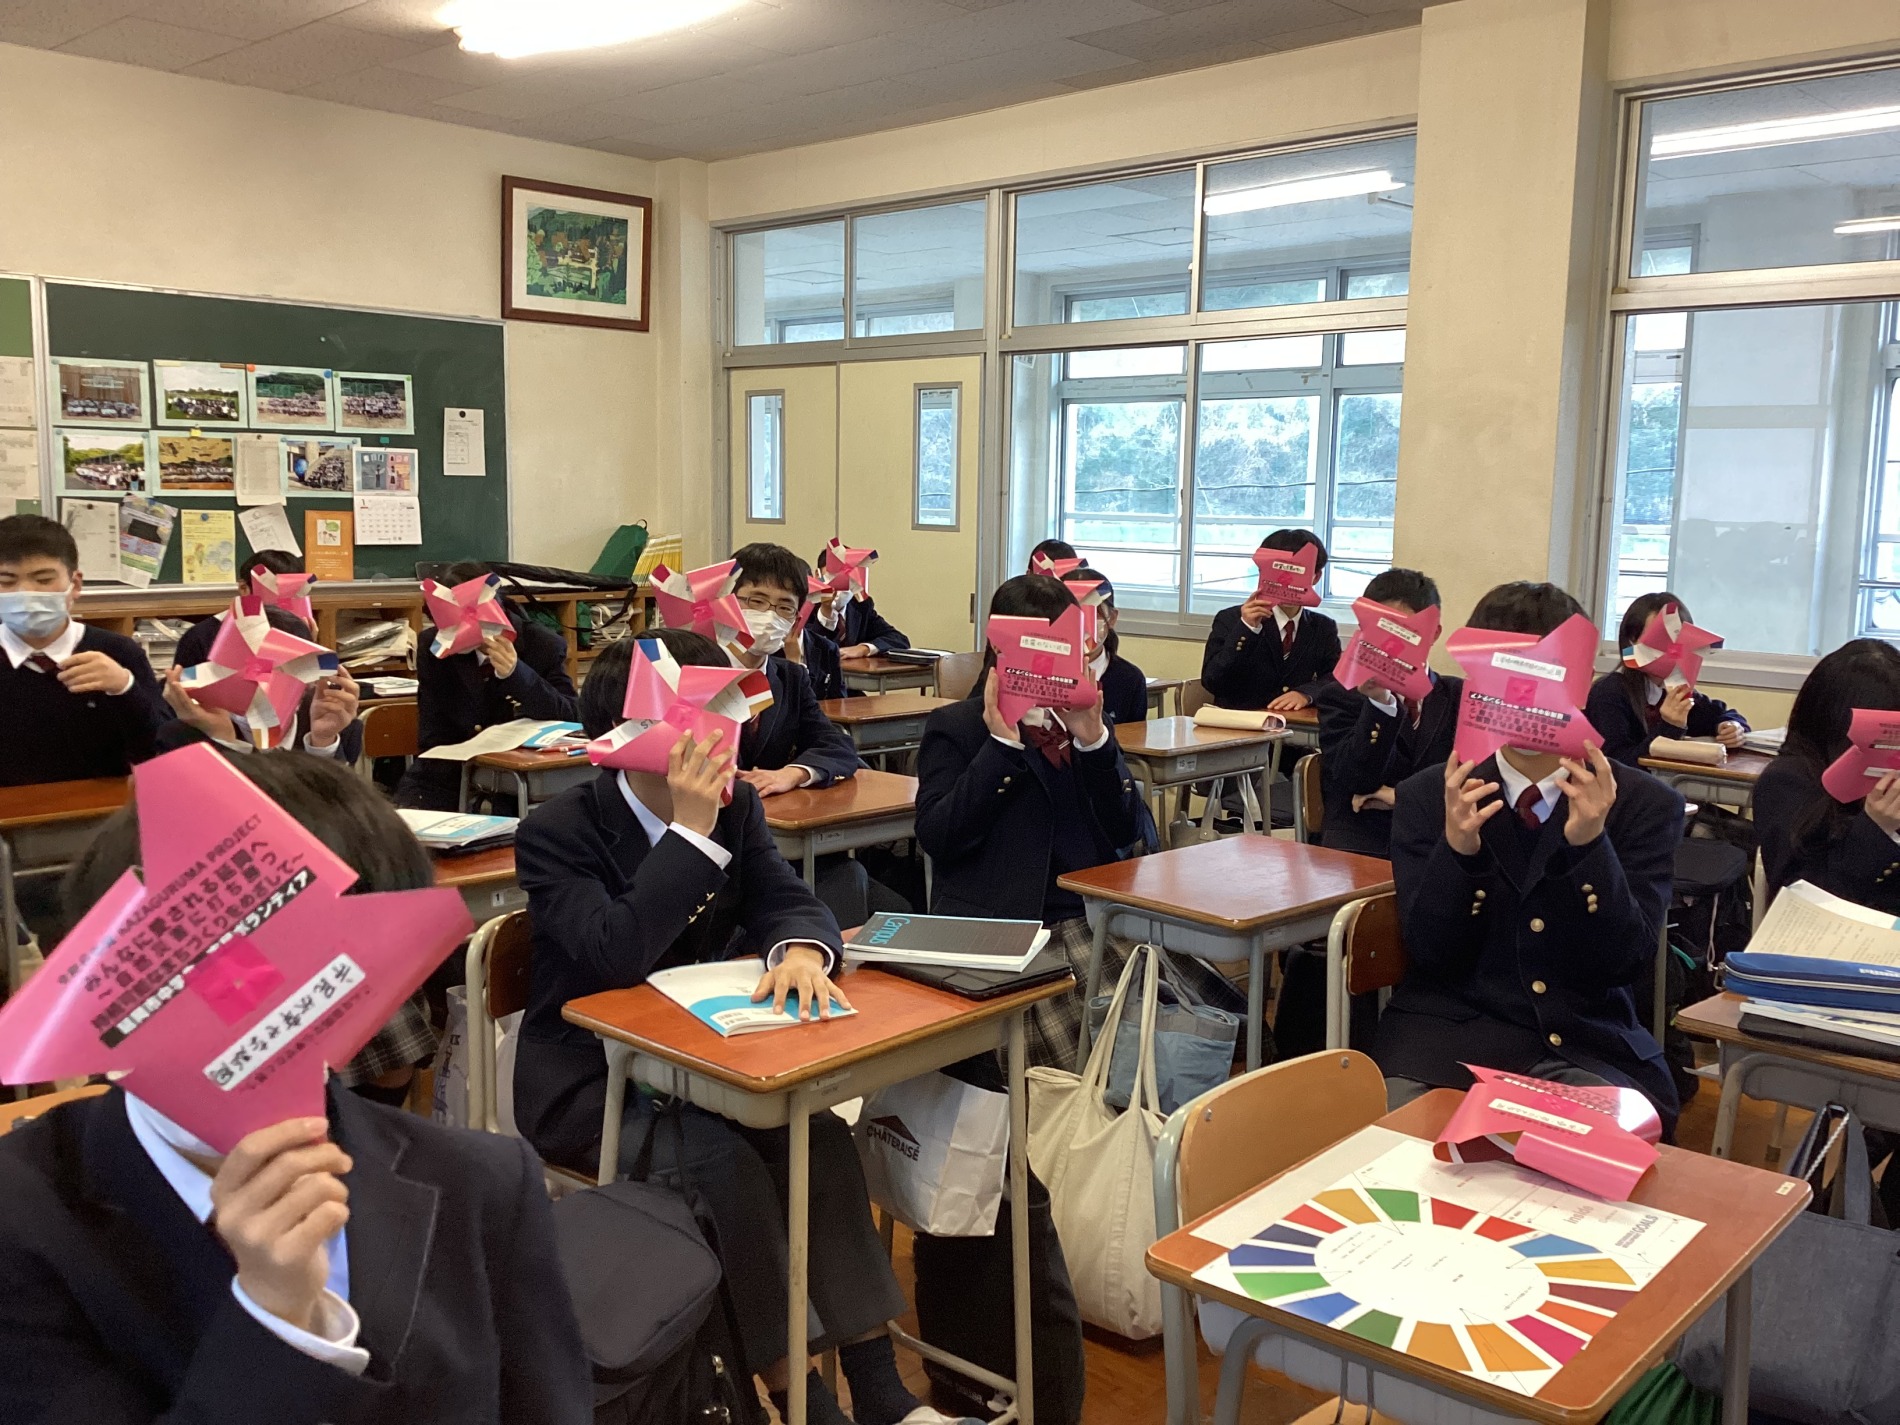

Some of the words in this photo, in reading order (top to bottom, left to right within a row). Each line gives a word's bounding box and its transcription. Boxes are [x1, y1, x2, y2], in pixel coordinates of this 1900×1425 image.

[206, 813, 263, 863] PROJECT
[869, 917, 911, 945] Campus
[1632, 1215, 1659, 1233] GOALS
